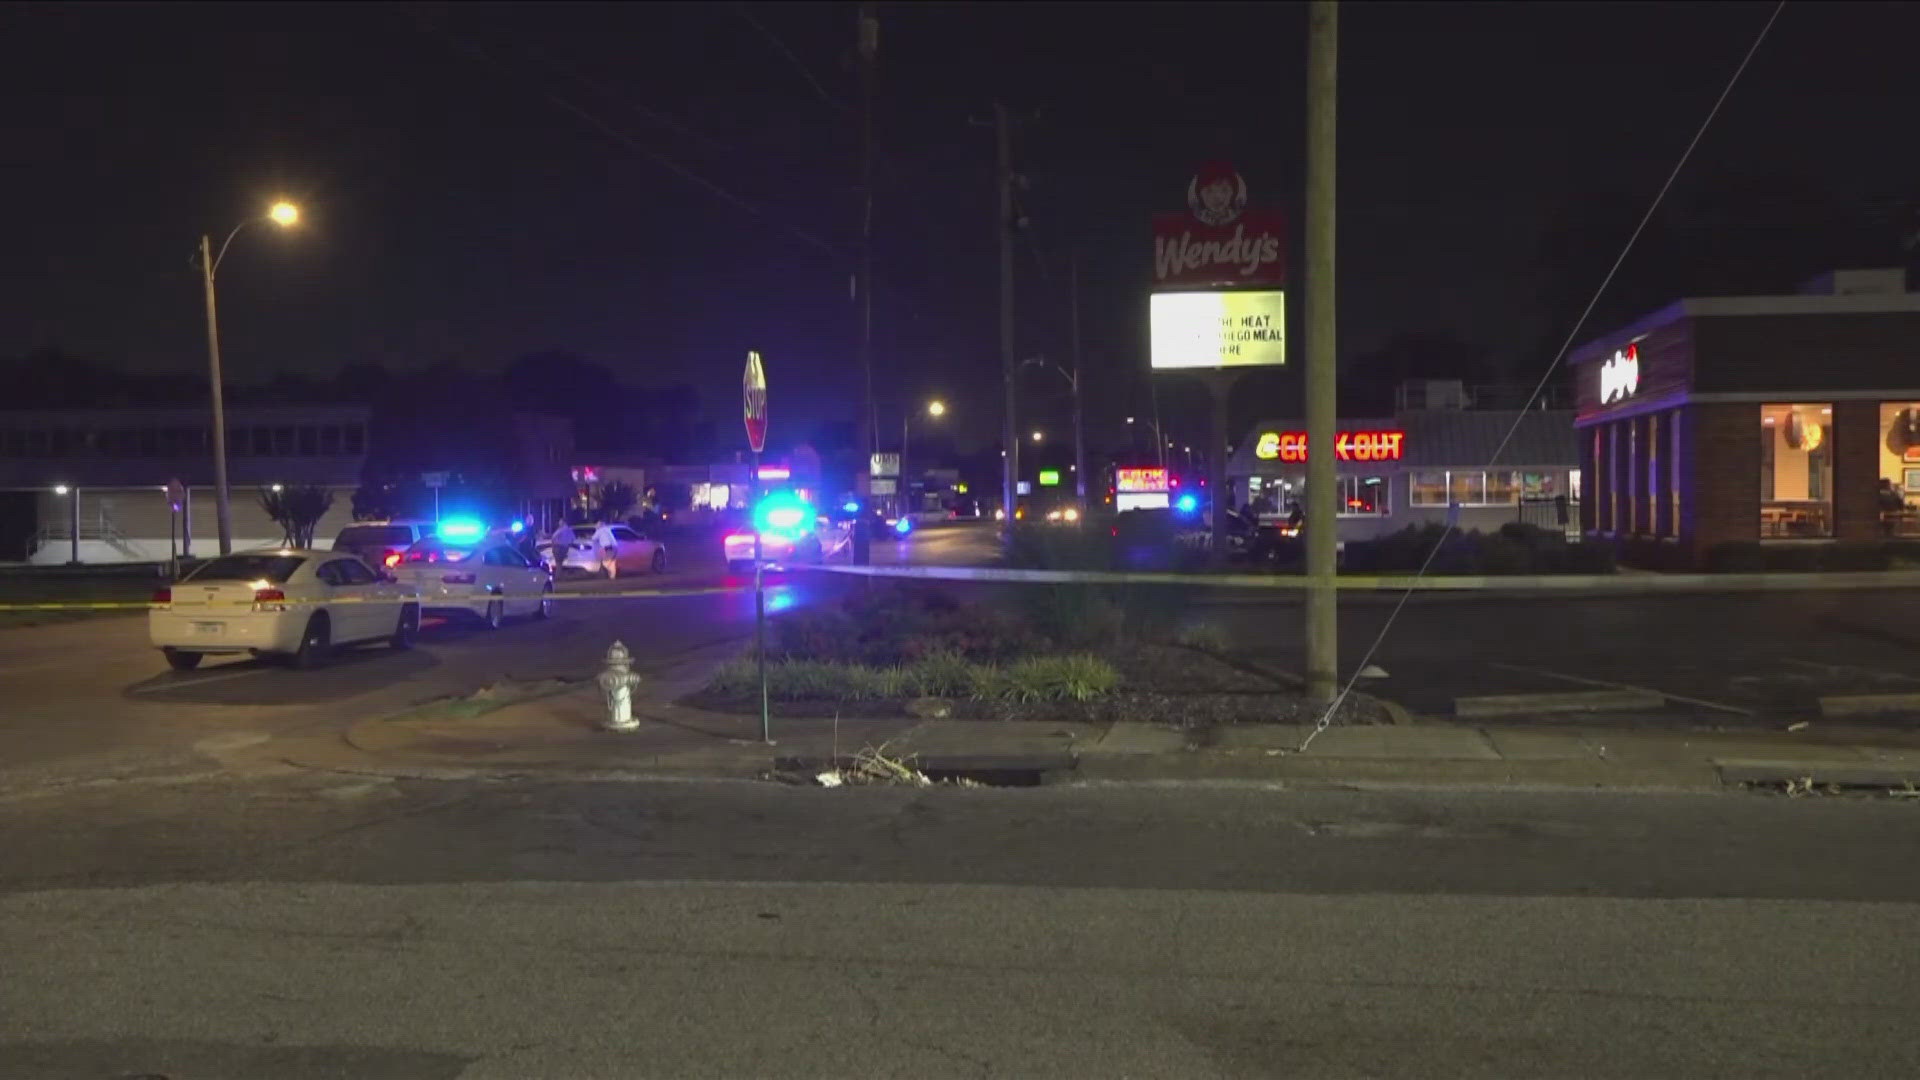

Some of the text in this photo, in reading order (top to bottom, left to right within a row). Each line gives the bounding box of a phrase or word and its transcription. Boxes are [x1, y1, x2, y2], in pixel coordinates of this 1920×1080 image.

[1155, 224, 1279, 280] Wendy's
[1241, 315, 1270, 327] HEAT
[1253, 329, 1282, 341] MEAL
[745, 386, 765, 420] STOP
[1354, 432, 1403, 461] OUT
